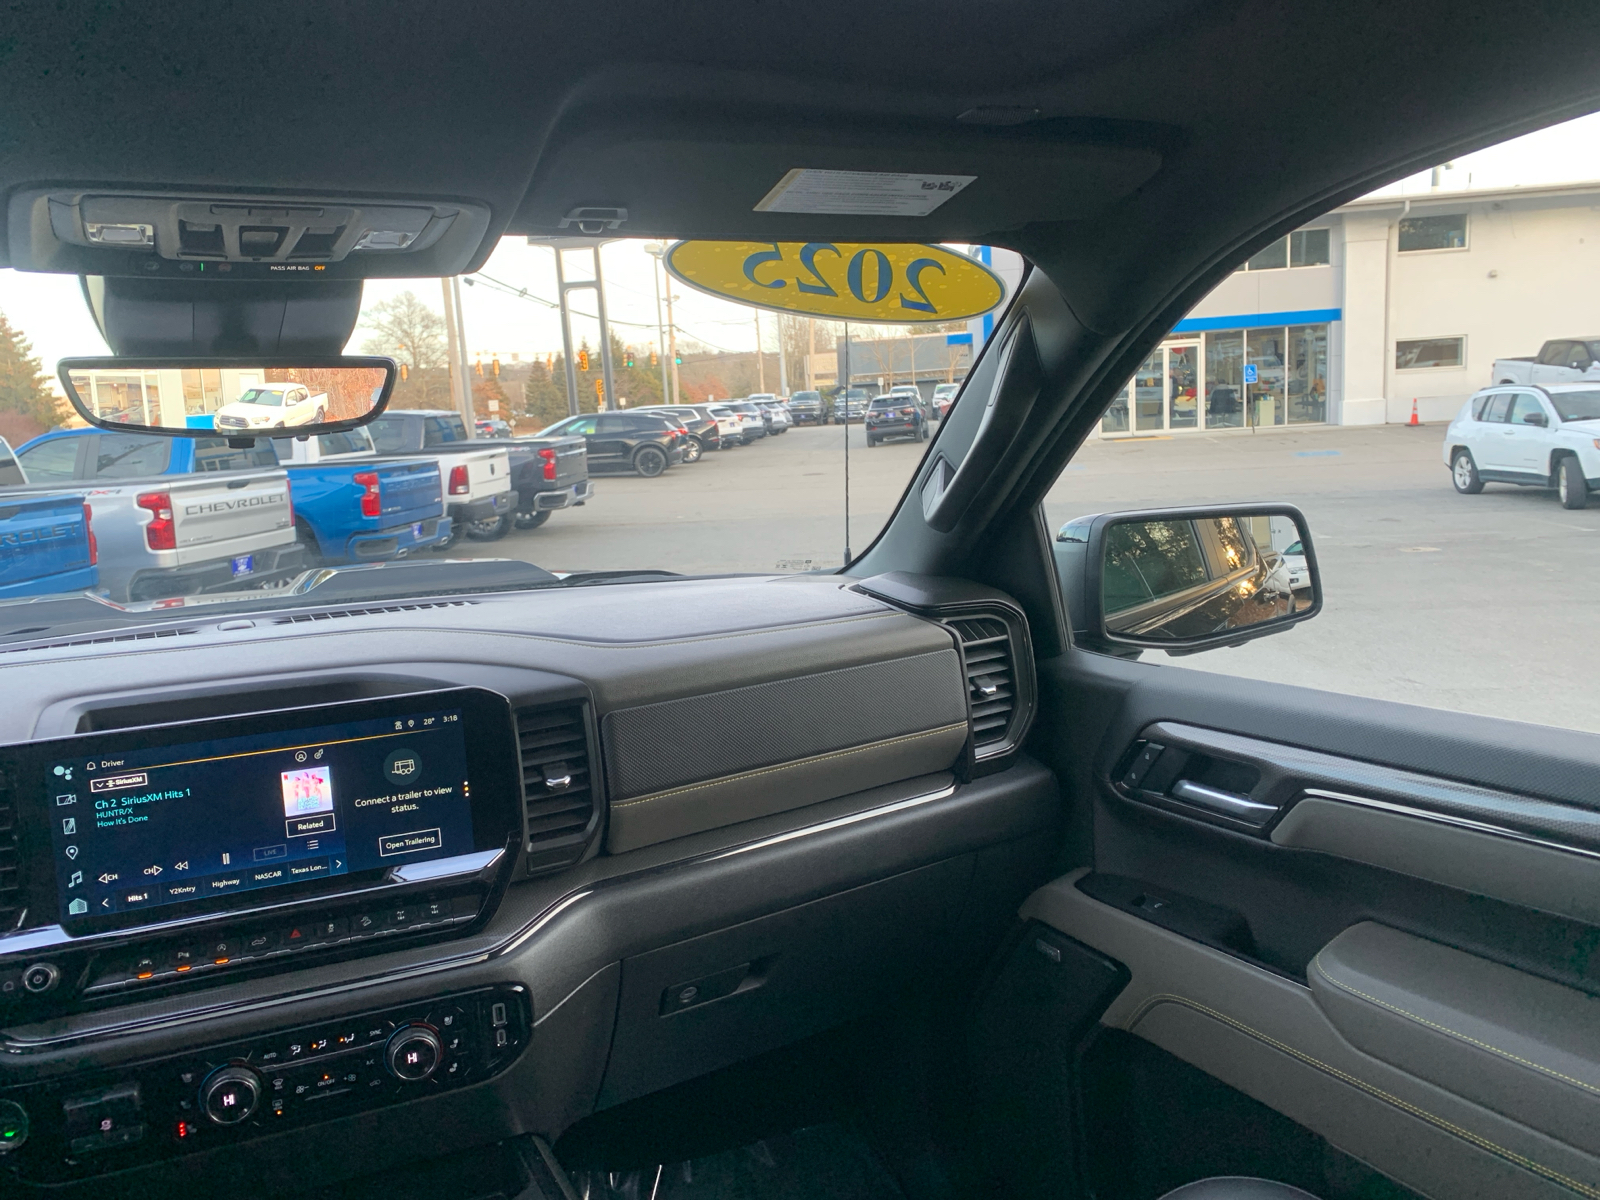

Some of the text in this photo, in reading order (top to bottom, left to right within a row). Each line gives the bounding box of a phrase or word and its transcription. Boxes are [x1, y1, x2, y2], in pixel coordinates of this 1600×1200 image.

[185, 493, 286, 516] CHEVROLET
[443, 714, 458, 723] 3:18
[101, 759, 125, 769] Driver
[115, 776, 143, 786] SiriusXM
[94, 788, 191, 810] Ch 2 SiriusXM Hits 1
[355, 786, 453, 807] Connect a trailer to view
[96, 807, 133, 818] HUNTR/X
[391, 802, 420, 814] status.
[97, 814, 149, 828] How It's Done
[297, 820, 324, 831] Related
[386, 835, 435, 851] Open Trailering
[263, 848, 277, 857] LIVE
[143, 868, 155, 876] CH
[254, 870, 282, 881] NASCAR
[291, 866, 309, 875] Texas
[107, 873, 118, 881] CH
[212, 877, 240, 889] Highway
[169, 885, 196, 896] Y2Kntry
[127, 893, 148, 903] Hits 1
[369, 1028, 382, 1037] SYNC
[263, 1052, 277, 1060] AUTO
[407, 1052, 418, 1064] HI
[317, 1078, 336, 1087] ON/OFF
[223, 1093, 235, 1107] HI
